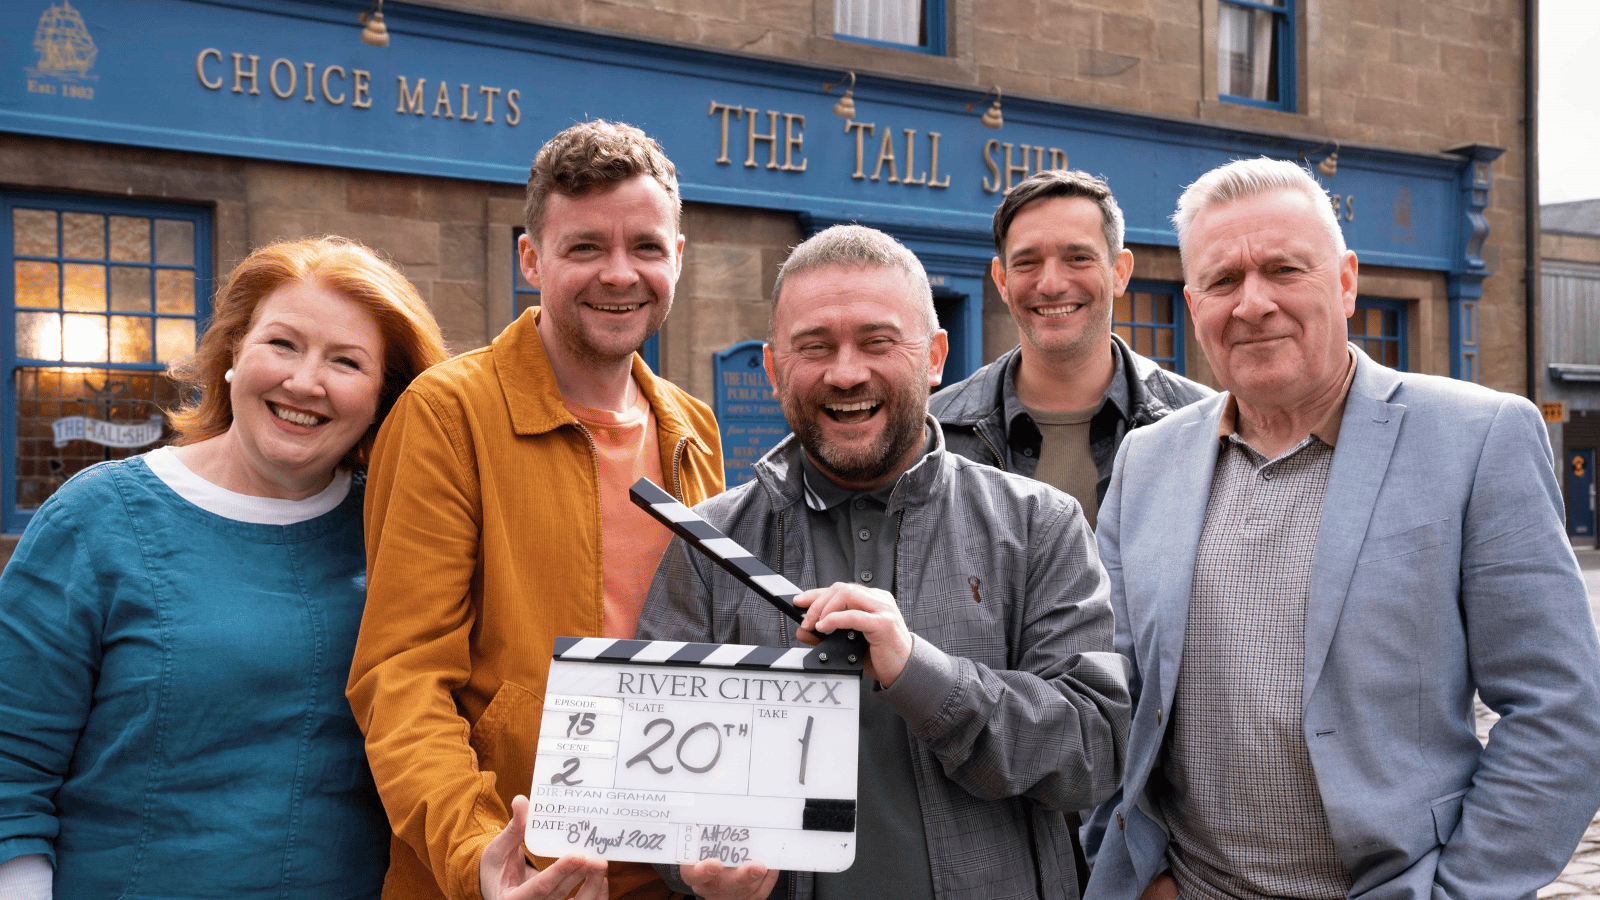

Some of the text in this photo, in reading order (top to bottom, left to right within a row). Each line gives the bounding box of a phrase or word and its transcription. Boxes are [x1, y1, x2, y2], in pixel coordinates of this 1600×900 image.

[196, 47, 521, 126] CHOICE MALTS
[707, 100, 807, 172] THE
[844, 119, 950, 188] TALL
[56, 419, 158, 444] THE TALL SHIP
[617, 672, 708, 698] RIVER
[554, 698, 597, 709] EPISODE
[628, 702, 665, 713] SLATE
[758, 708, 788, 719] TAKE
[566, 712, 597, 738] 15
[556, 742, 590, 752] SCENE
[798, 715, 814, 785] 1
[551, 757, 584, 786] 2
[564, 789, 602, 799] RYAN
[606, 791, 666, 802] GRAHAM
[567, 805, 609, 815] BRIAN
[612, 808, 669, 819] JOBSON
[583, 826, 626, 855] August
[624, 829, 667, 850] 2022
